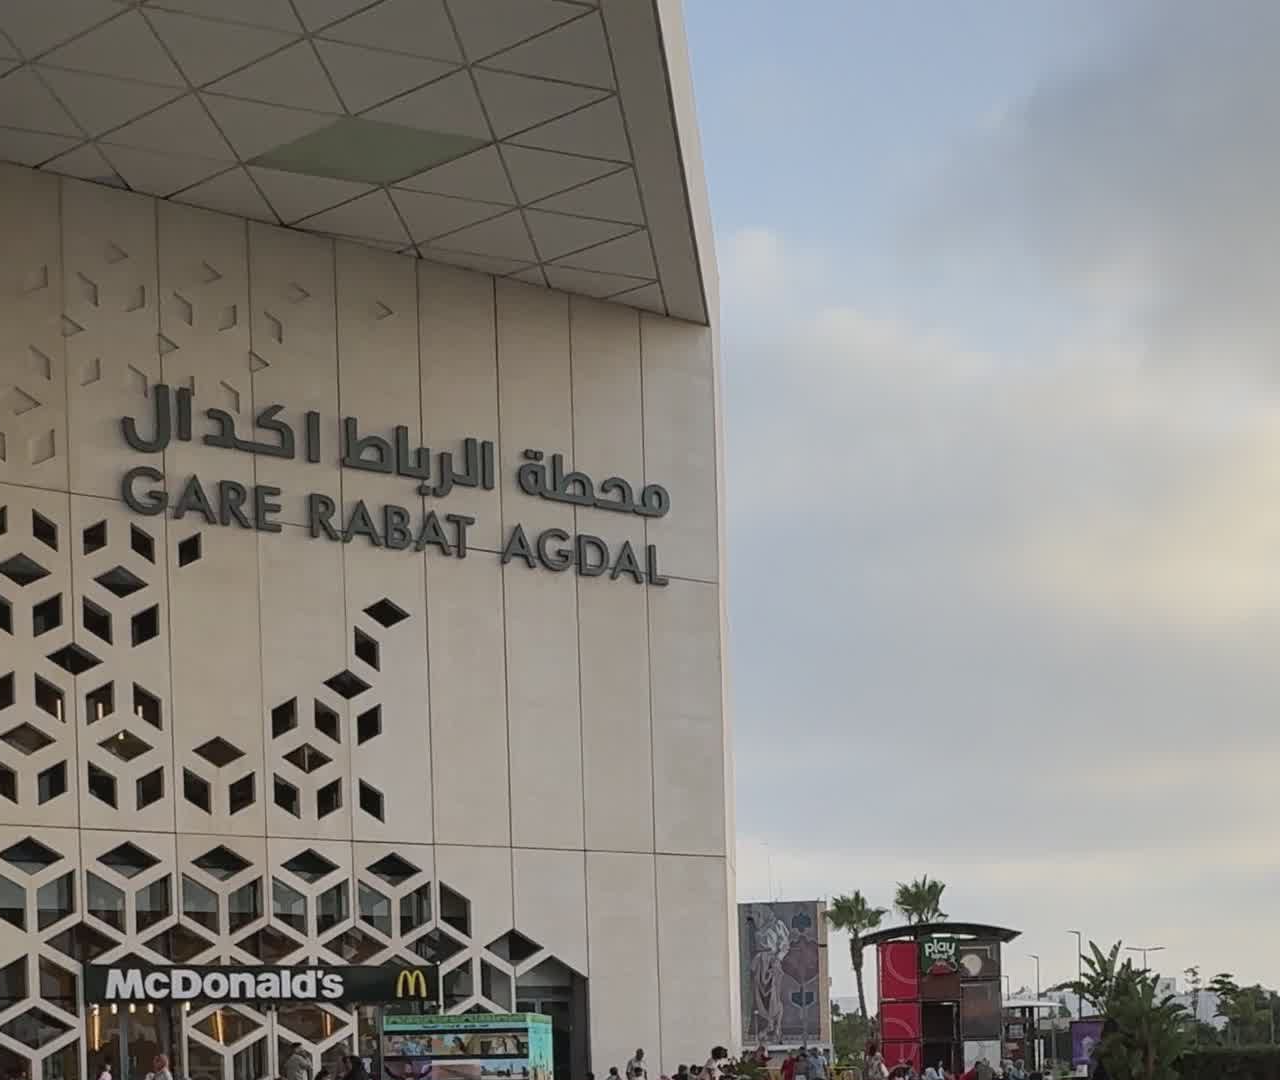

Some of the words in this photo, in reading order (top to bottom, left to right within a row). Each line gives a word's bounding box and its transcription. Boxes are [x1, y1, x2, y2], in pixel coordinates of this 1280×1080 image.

[121, 384, 321, 463] اكدال
[341, 417, 495, 497] الرباط
[519, 449, 670, 518] محطة
[121, 466, 282, 533] GARE
[308, 493, 476, 559] RABAT
[500, 522, 670, 586] AGDAL
[105, 966, 344, 1000] McDonald's
[924, 939, 956, 957] play
